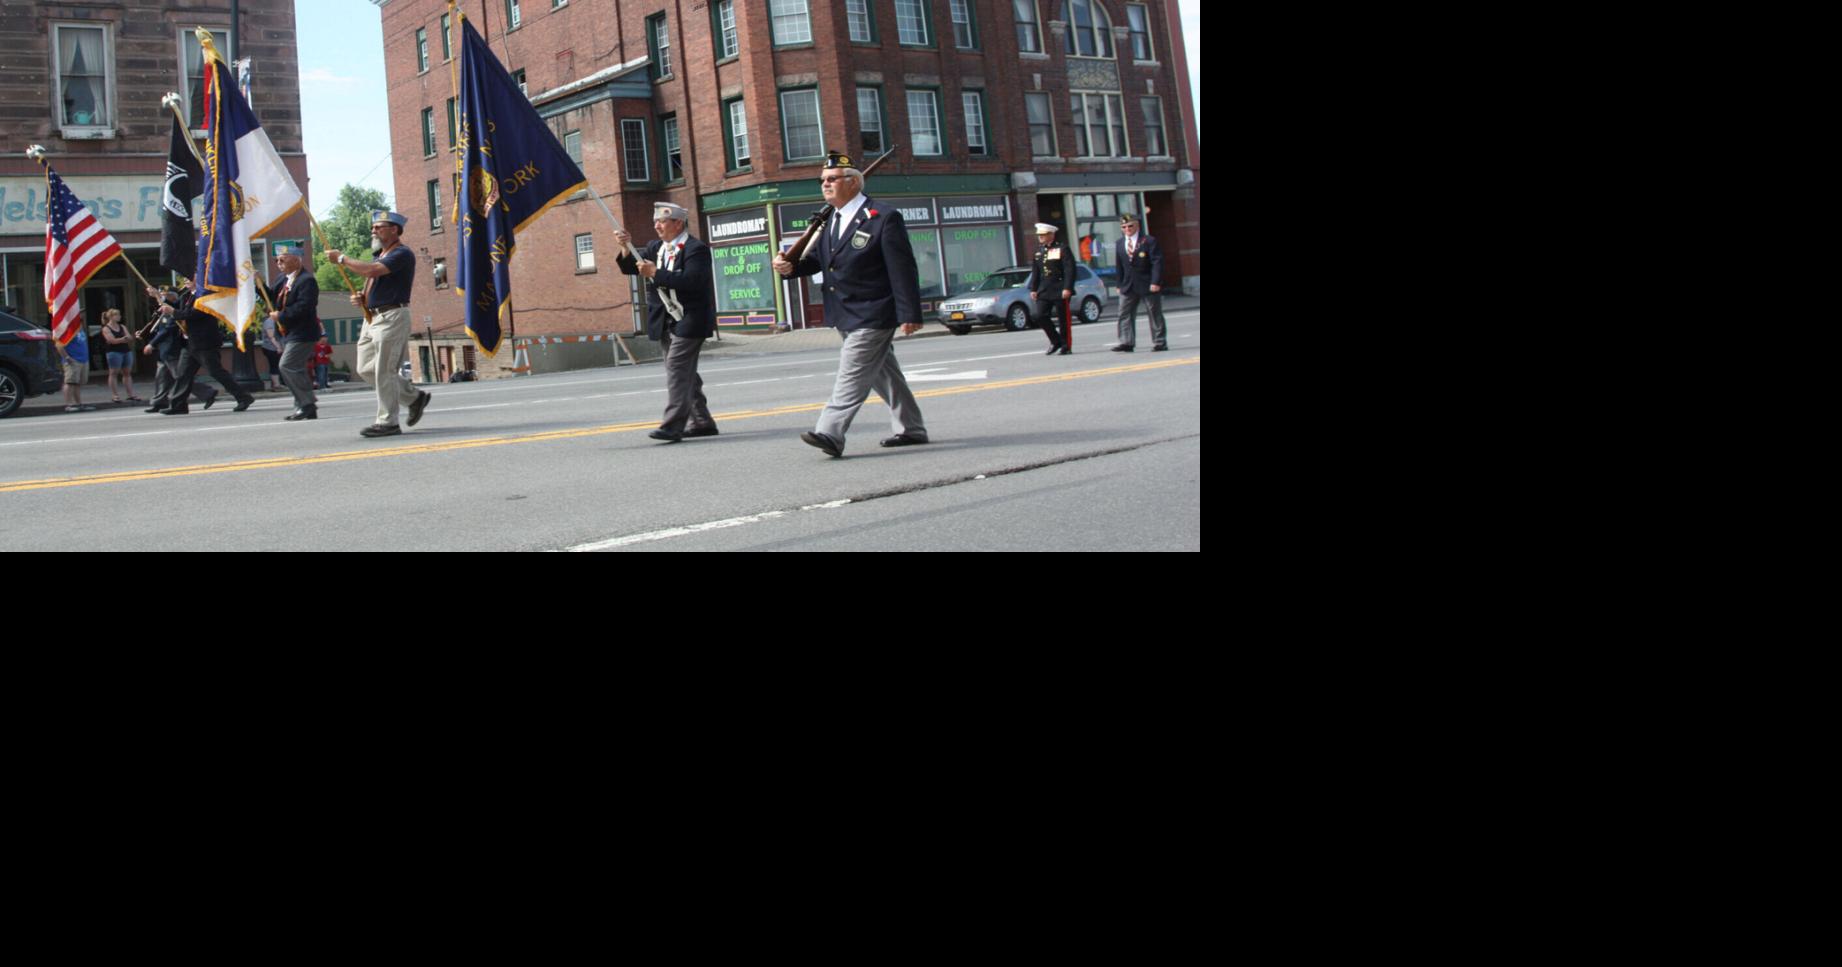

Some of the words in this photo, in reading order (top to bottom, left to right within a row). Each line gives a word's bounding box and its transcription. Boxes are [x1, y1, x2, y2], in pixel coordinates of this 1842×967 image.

[942, 205, 1004, 219] LAUNDROMAT
[711, 217, 765, 237] LAUNDROMAT
[954, 230, 978, 240] DROP
[981, 227, 998, 239] OFF
[714, 247, 729, 259] DRY
[730, 243, 770, 257] CLEANING
[739, 256, 745, 265] &
[724, 264, 745, 276] DROP
[747, 263, 762, 274] OFF
[729, 288, 761, 300] SERVICE
